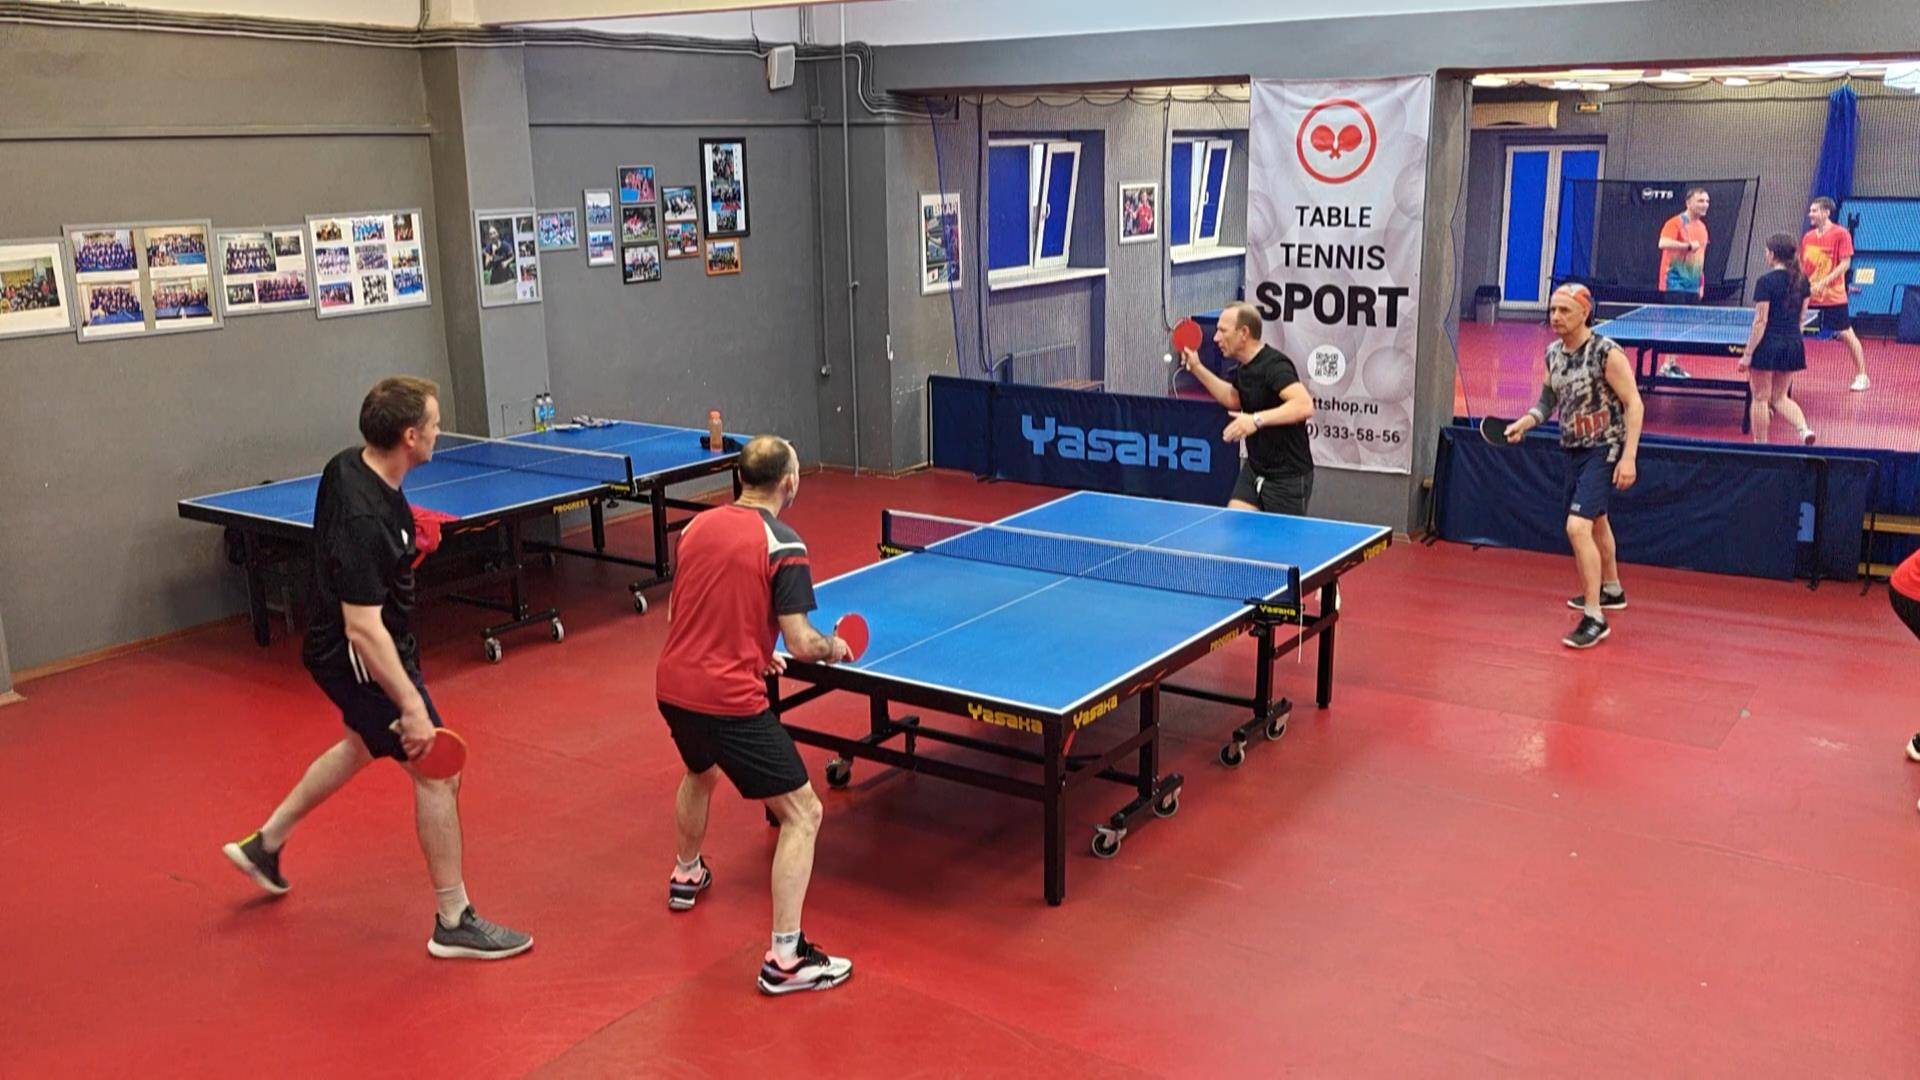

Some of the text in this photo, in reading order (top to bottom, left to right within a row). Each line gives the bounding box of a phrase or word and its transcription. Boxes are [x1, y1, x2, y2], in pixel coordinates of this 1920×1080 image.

[1295, 206, 1372, 228] TABLE
[1280, 243, 1386, 271] TENNIS
[1256, 281, 1409, 328] SPORT
[1312, 397, 1379, 416] ttshop.ru
[1021, 414, 1211, 473] Yasaka
[1323, 425, 1400, 444] 333-58-56
[967, 702, 1044, 735] Yasaka
[1073, 694, 1118, 730] Yasaka
